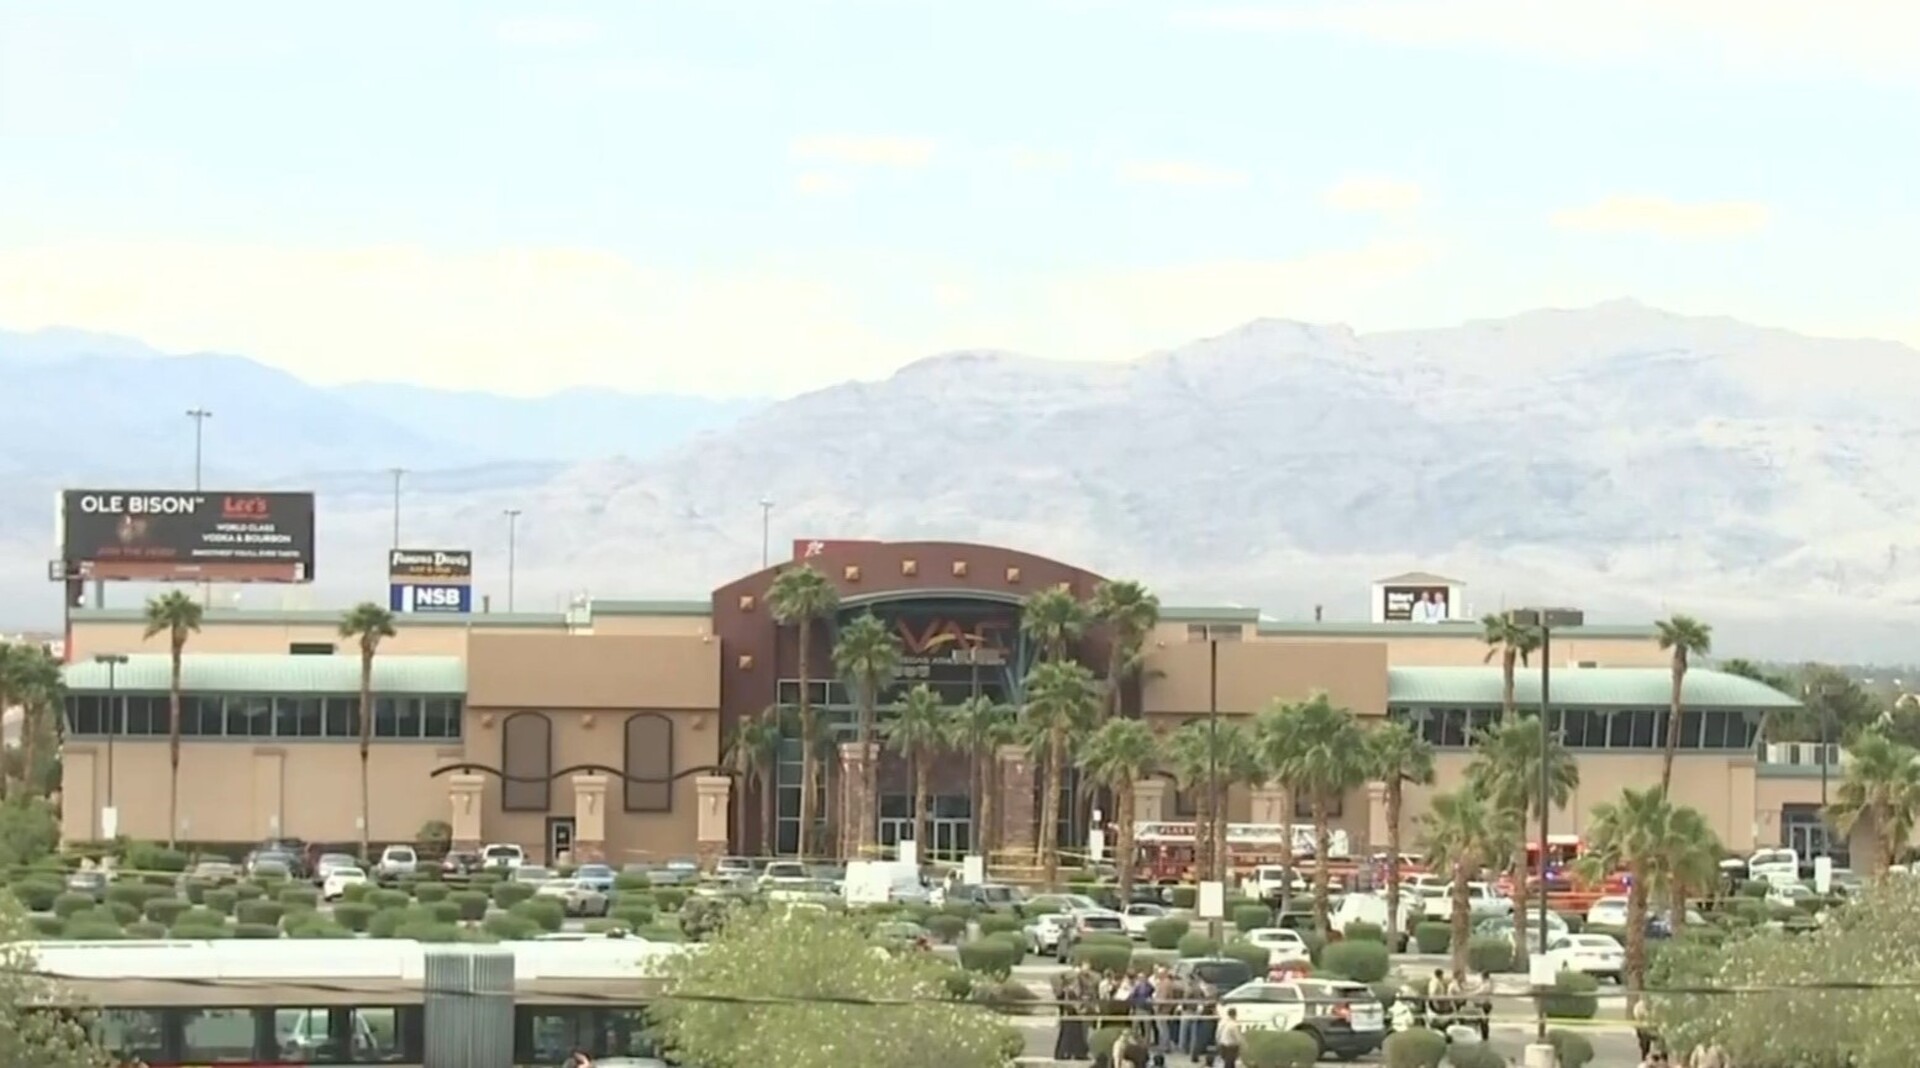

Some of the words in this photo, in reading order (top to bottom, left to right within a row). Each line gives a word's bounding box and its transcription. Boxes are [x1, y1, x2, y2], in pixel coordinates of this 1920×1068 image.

[80, 496, 123, 513] OLE
[224, 496, 267, 512] Lee's
[202, 533, 235, 543] VODKA
[236, 534, 243, 543] &
[244, 534, 292, 544] BOURBON
[417, 587, 460, 605] NSB
